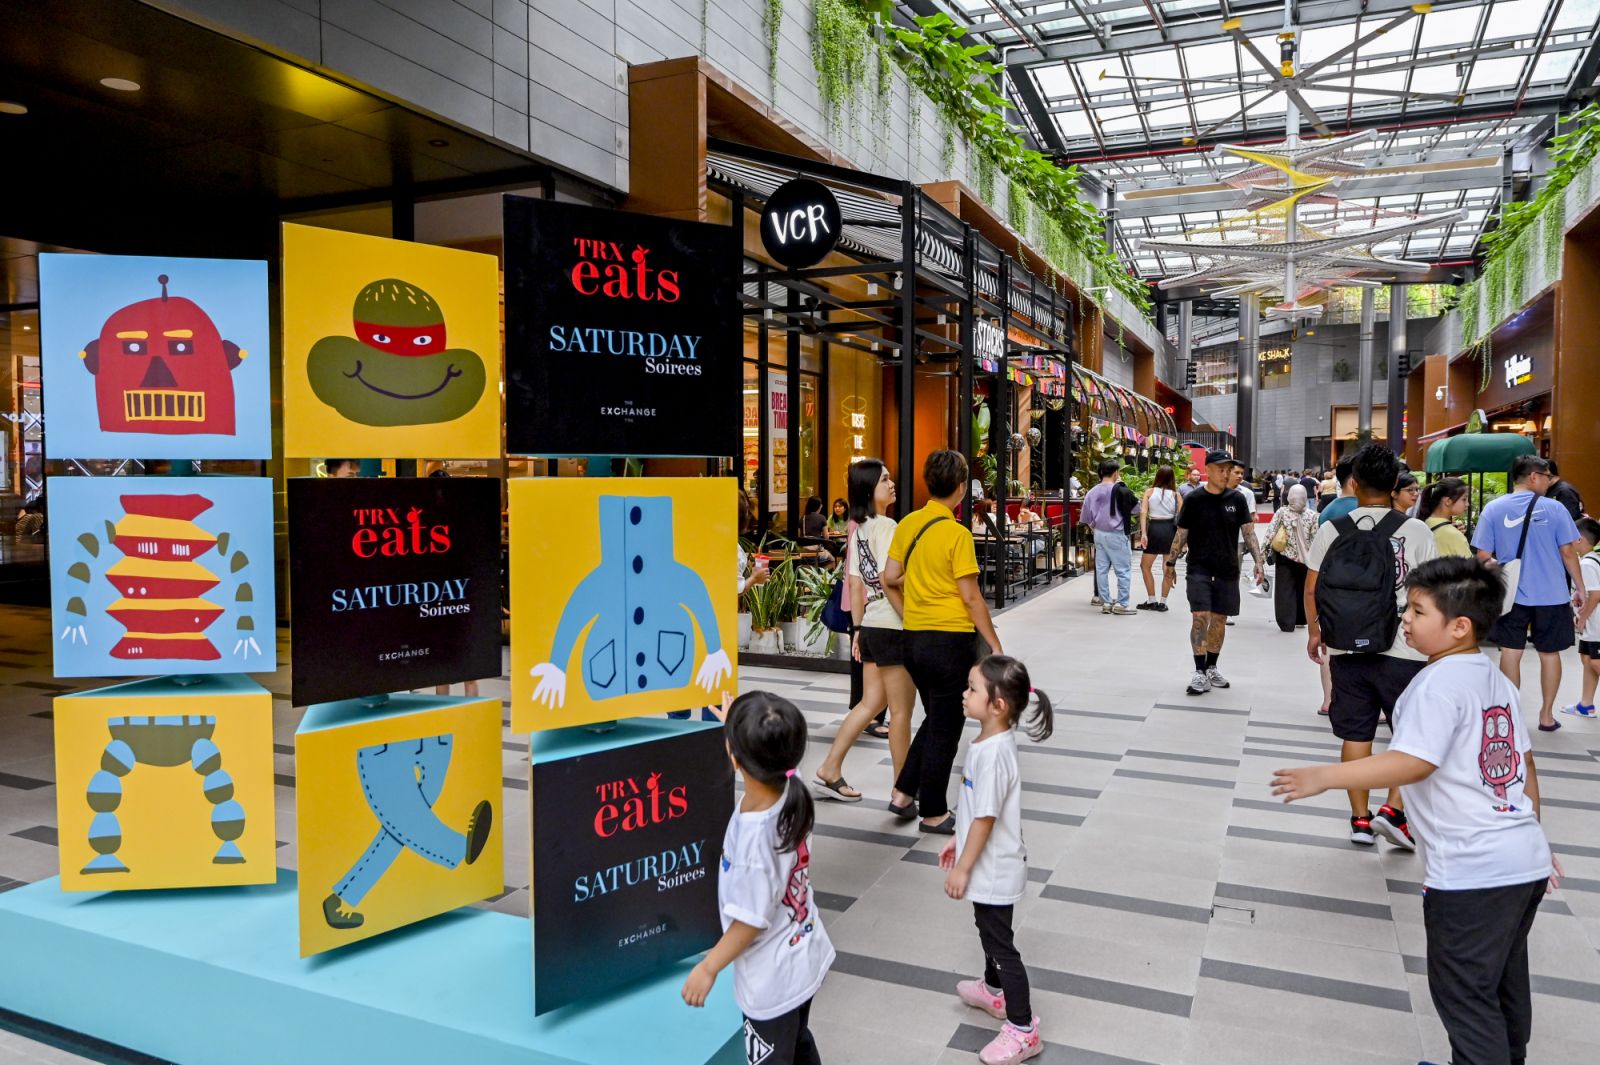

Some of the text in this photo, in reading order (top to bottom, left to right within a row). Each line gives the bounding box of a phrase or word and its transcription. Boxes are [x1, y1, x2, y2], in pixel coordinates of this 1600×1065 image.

[771, 204, 830, 244] VCR
[573, 237, 624, 262] TRX
[571, 246, 680, 303] eats
[550, 325, 702, 359] SATURDAY
[977, 321, 1005, 358] STACKS
[645, 357, 702, 376] Soirees
[600, 406, 656, 416] EXCHANGE
[353, 508, 400, 526] TRX
[352, 507, 452, 558] eats
[331, 578, 470, 612] SATURDAY
[419, 602, 470, 618] Soirees
[379, 647, 430, 661] EXCHANGE
[596, 777, 640, 802] TRX
[594, 772, 688, 838] eats
[574, 839, 706, 903] SATURDAY
[657, 866, 706, 892] Soirees
[618, 923, 667, 948] EXCHANGE
